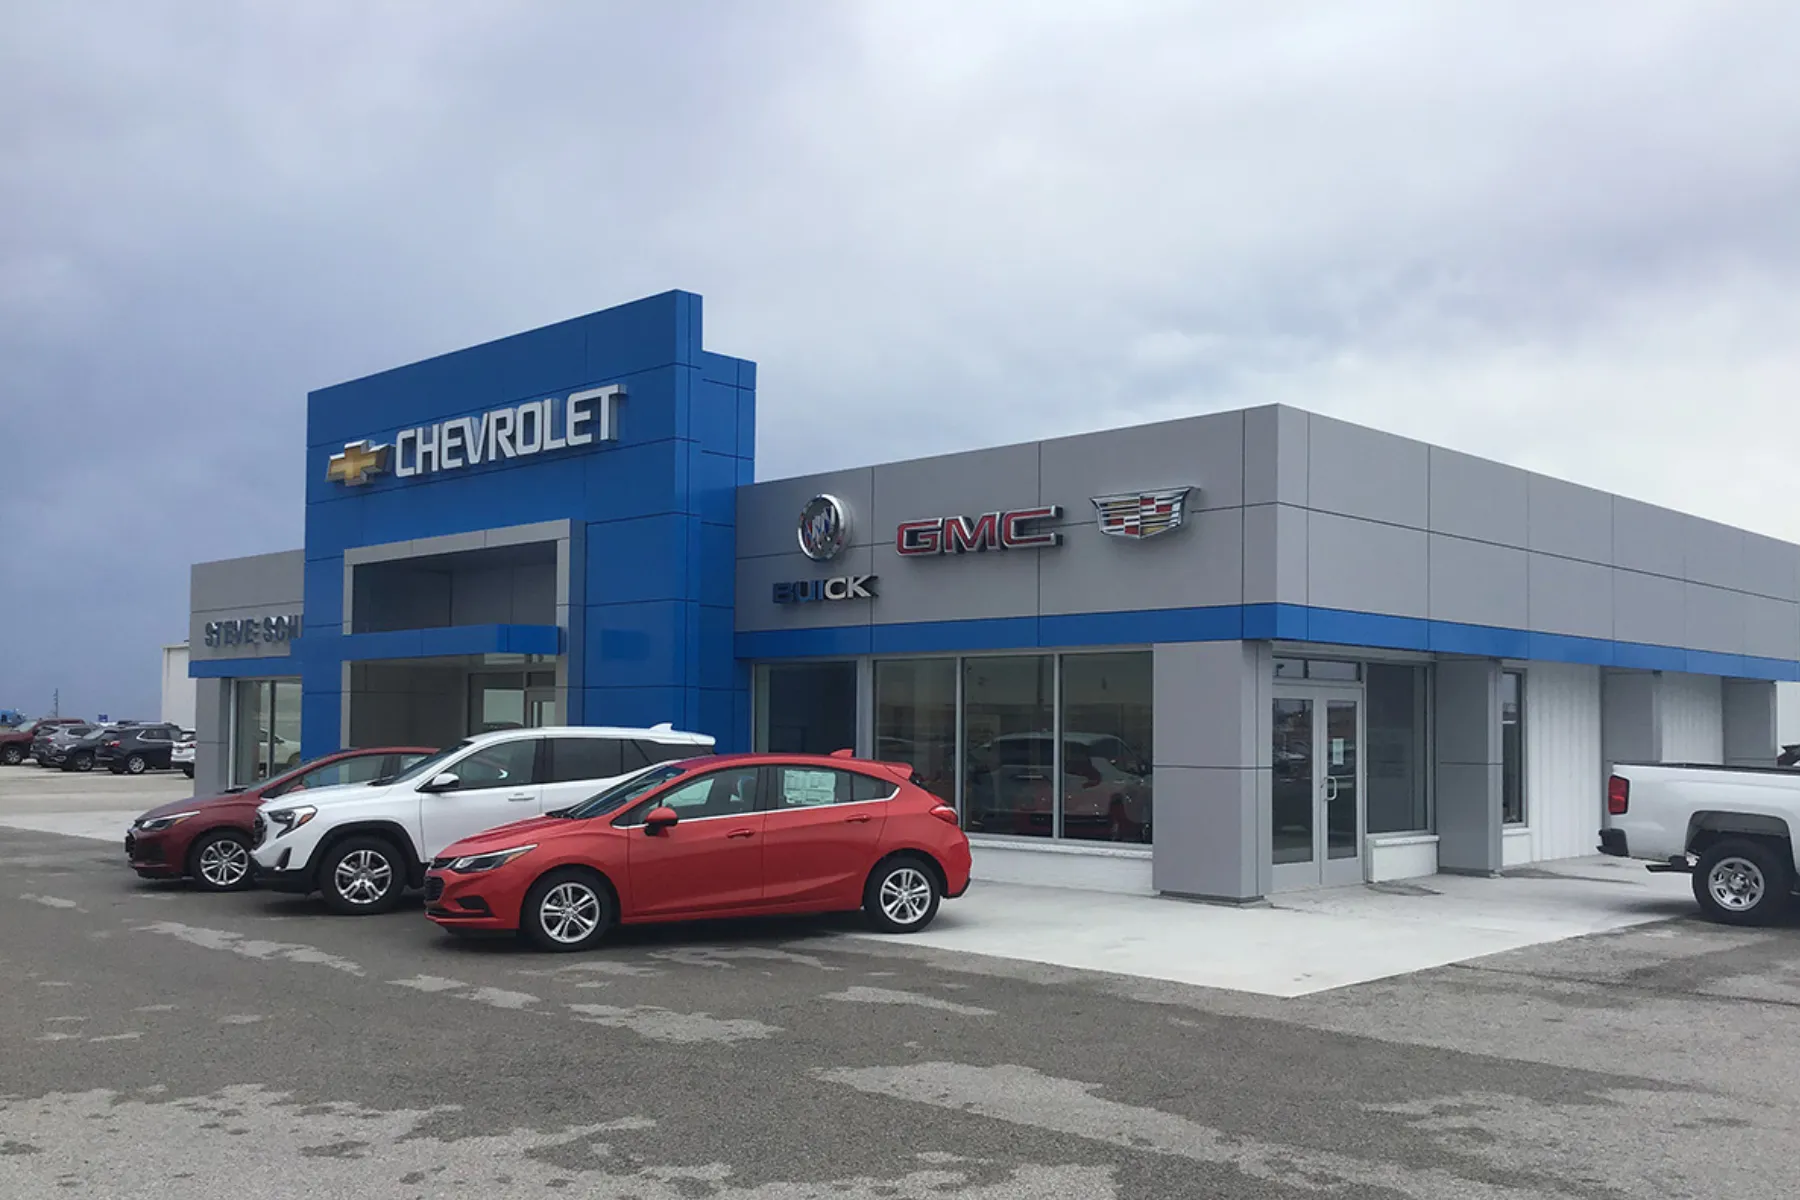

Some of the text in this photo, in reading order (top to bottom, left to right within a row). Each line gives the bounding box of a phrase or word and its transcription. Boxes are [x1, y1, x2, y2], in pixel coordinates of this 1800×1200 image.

[395, 383, 623, 478] CHEVROLET
[896, 504, 1061, 556] GMC
[772, 574, 876, 604] BUICK
[204, 619, 260, 648] STEVE
